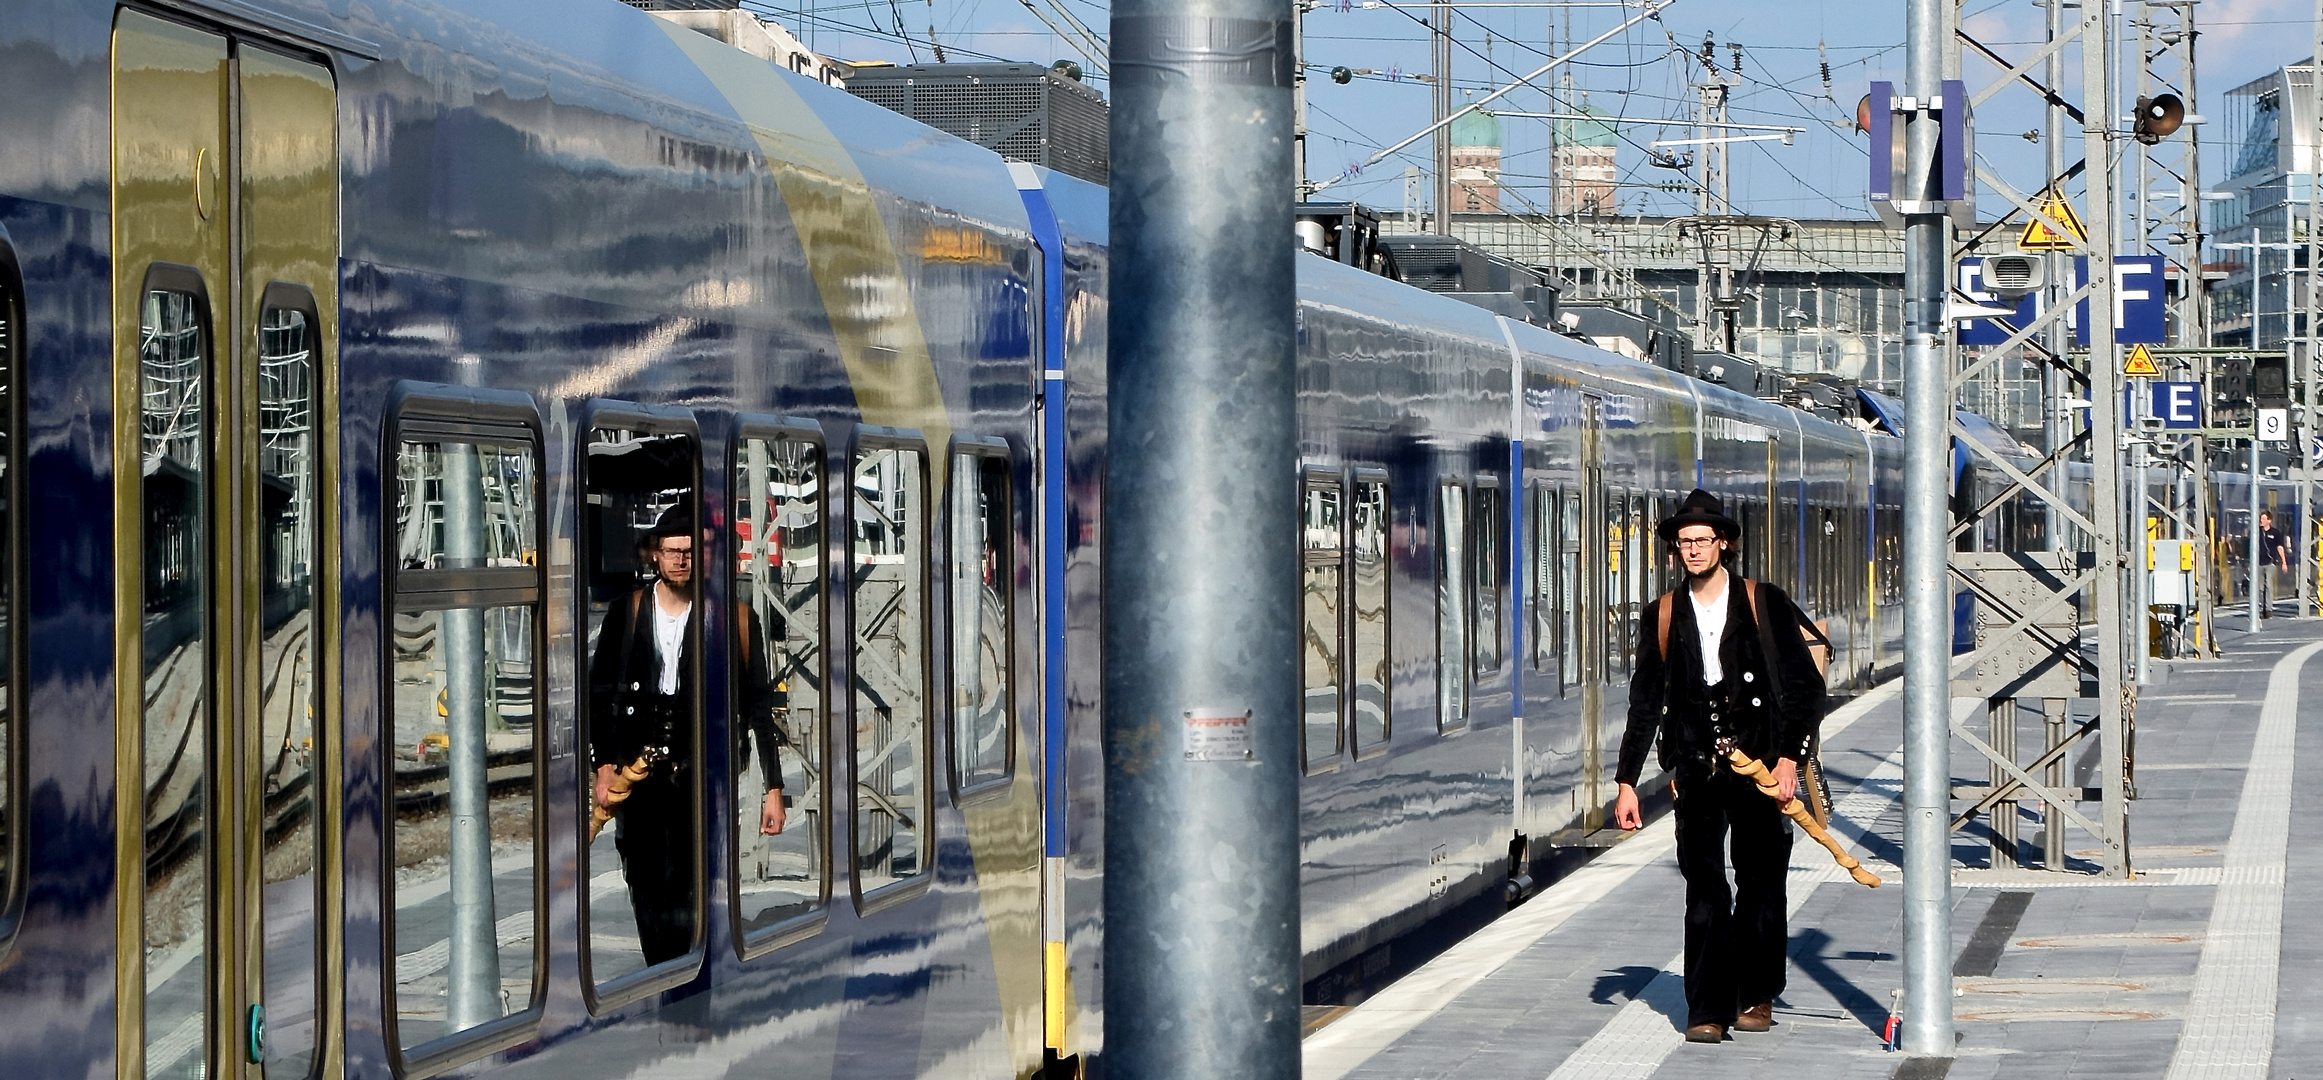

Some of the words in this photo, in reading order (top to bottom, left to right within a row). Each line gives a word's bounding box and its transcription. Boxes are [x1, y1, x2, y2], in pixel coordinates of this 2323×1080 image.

[2113, 263, 2152, 329] F
[2169, 385, 2194, 422] E
[2267, 415, 2279, 434] 9
